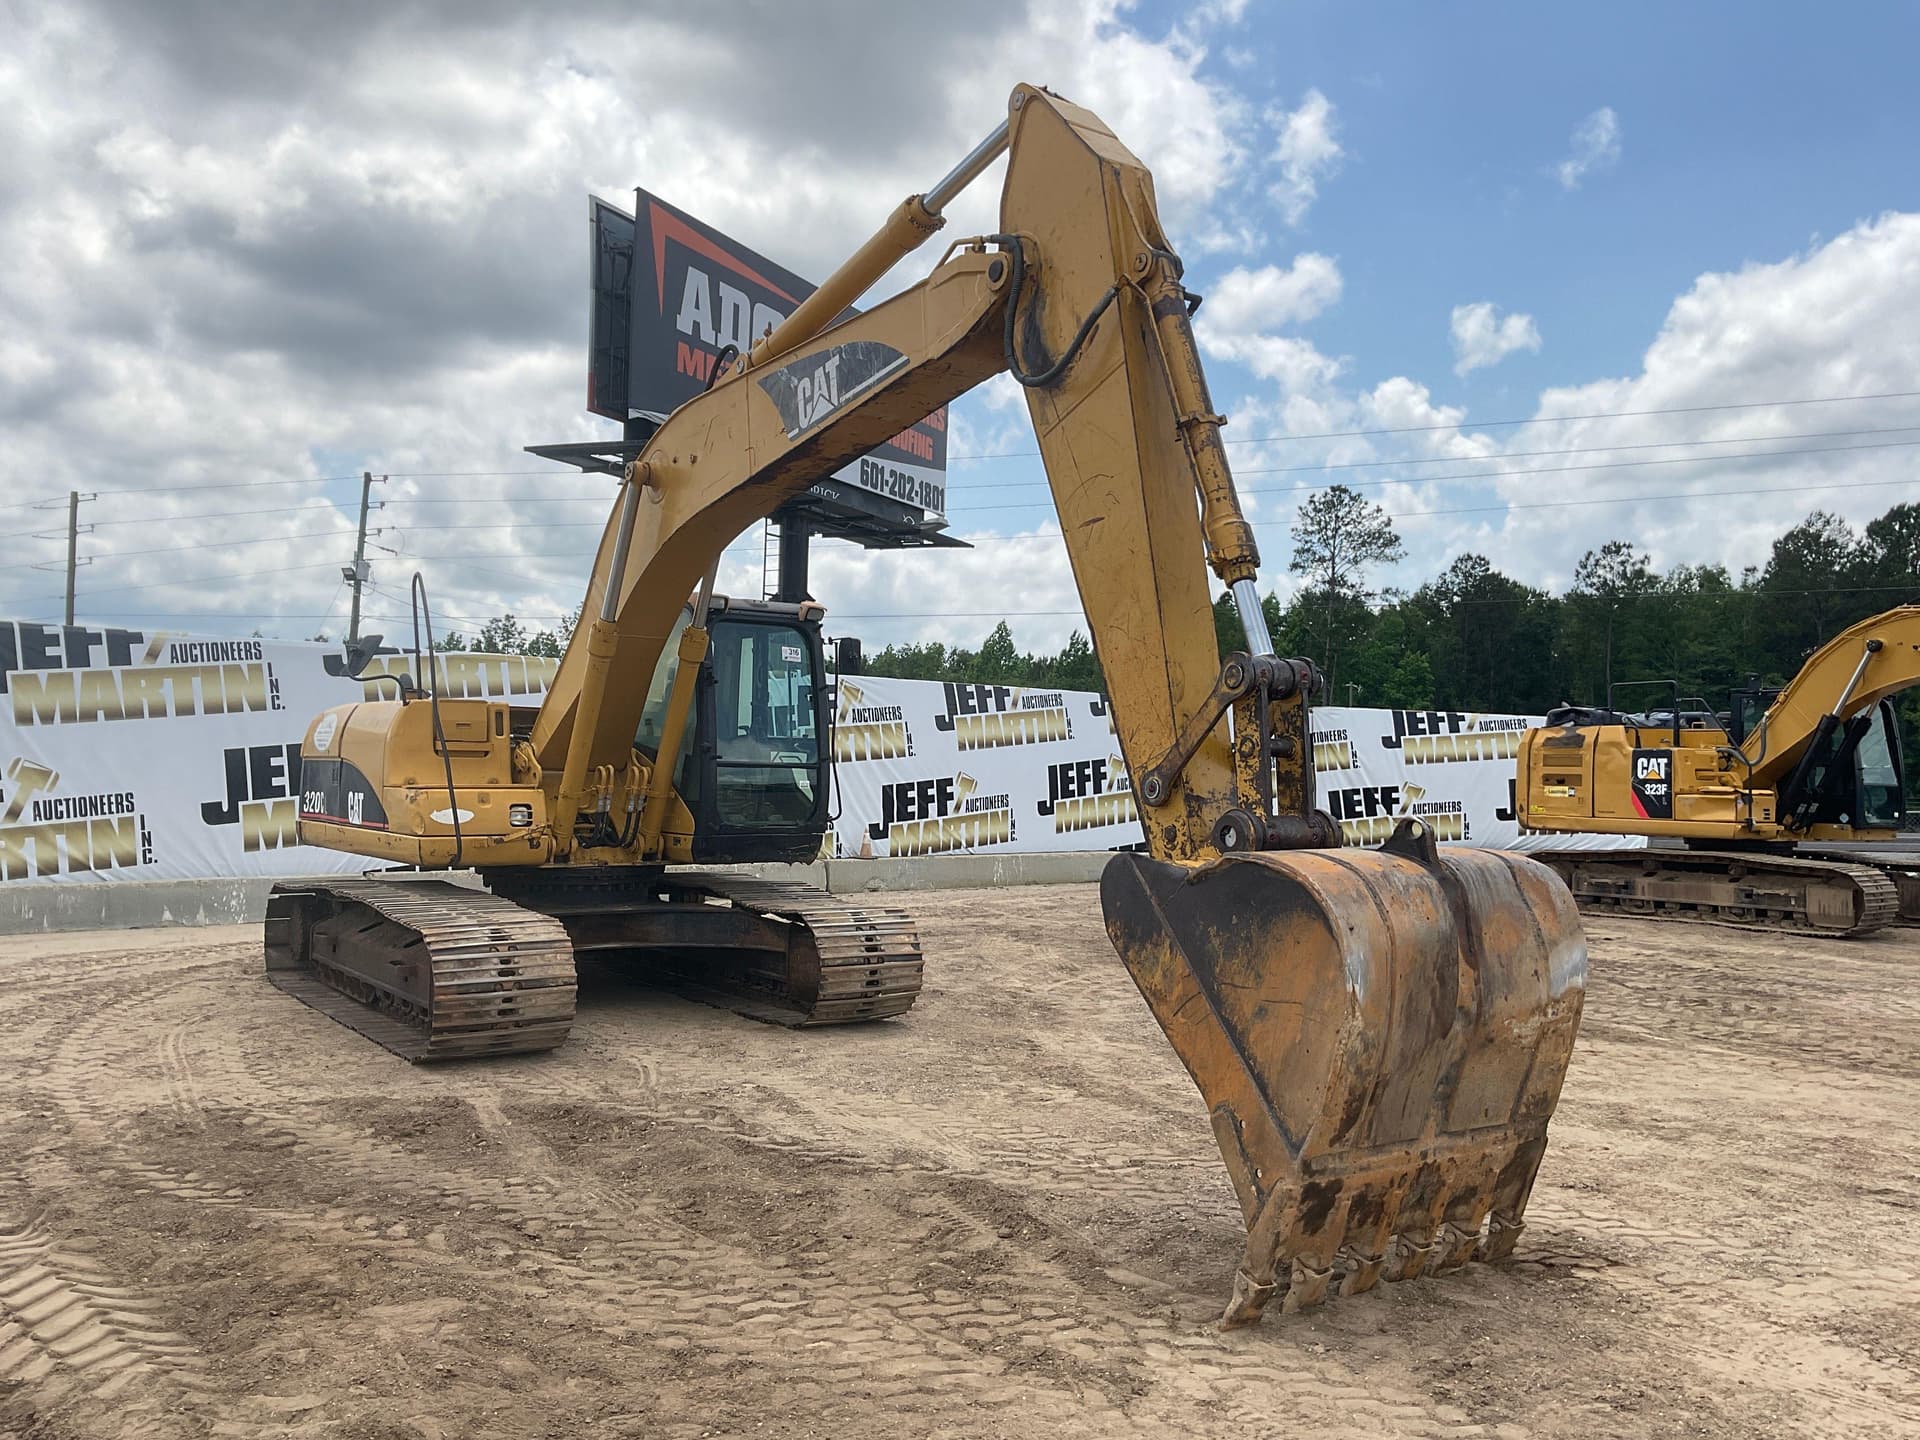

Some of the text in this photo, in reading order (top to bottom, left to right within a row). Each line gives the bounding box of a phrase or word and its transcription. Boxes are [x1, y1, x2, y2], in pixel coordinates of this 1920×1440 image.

[797, 353, 840, 429] CAT
[860, 458, 945, 513] 601-202-1801
[170, 641, 263, 664] AUCTIONEERS
[11, 662, 267, 727] MARTIN
[935, 682, 1011, 731] JEFF
[1022, 693, 1064, 710] AUCTIONEERS
[852, 706, 903, 724] AUCTIONEERS
[955, 709, 1067, 751] MARTIN
[1382, 711, 1528, 749] JEFF AUCTIONEERS
[1038, 758, 1108, 816] JEFF
[1637, 757, 1668, 780] CAT
[33, 792, 135, 822] AUCTIONEERS
[348, 791, 364, 825] CAT
[869, 777, 1010, 840] JEFF AUCTIONEERS
[1412, 801, 1462, 815] AUCTIONEERS
[1644, 783, 1668, 796] 323F
[1056, 793, 1139, 834] MARTI
[1340, 813, 1462, 847] MAIN
[890, 810, 1010, 858] MARTIN
